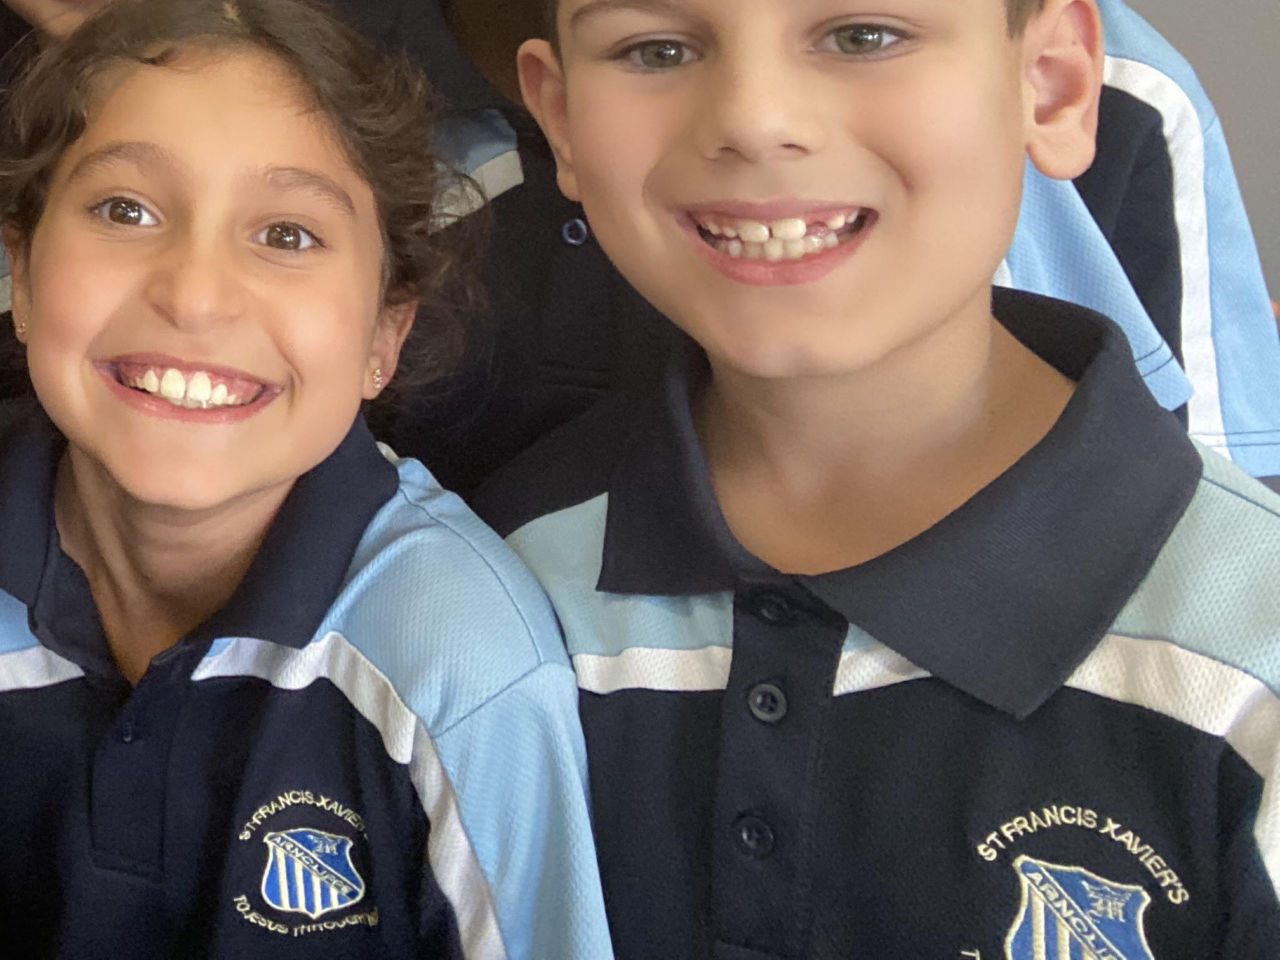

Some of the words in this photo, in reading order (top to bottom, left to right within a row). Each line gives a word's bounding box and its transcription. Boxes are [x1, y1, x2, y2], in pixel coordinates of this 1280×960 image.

[252, 790, 314, 825] FRANCIS
[976, 831, 1006, 861] ST
[1000, 805, 1098, 842] FRANCIS
[1099, 817, 1190, 905] XAVIER'S
